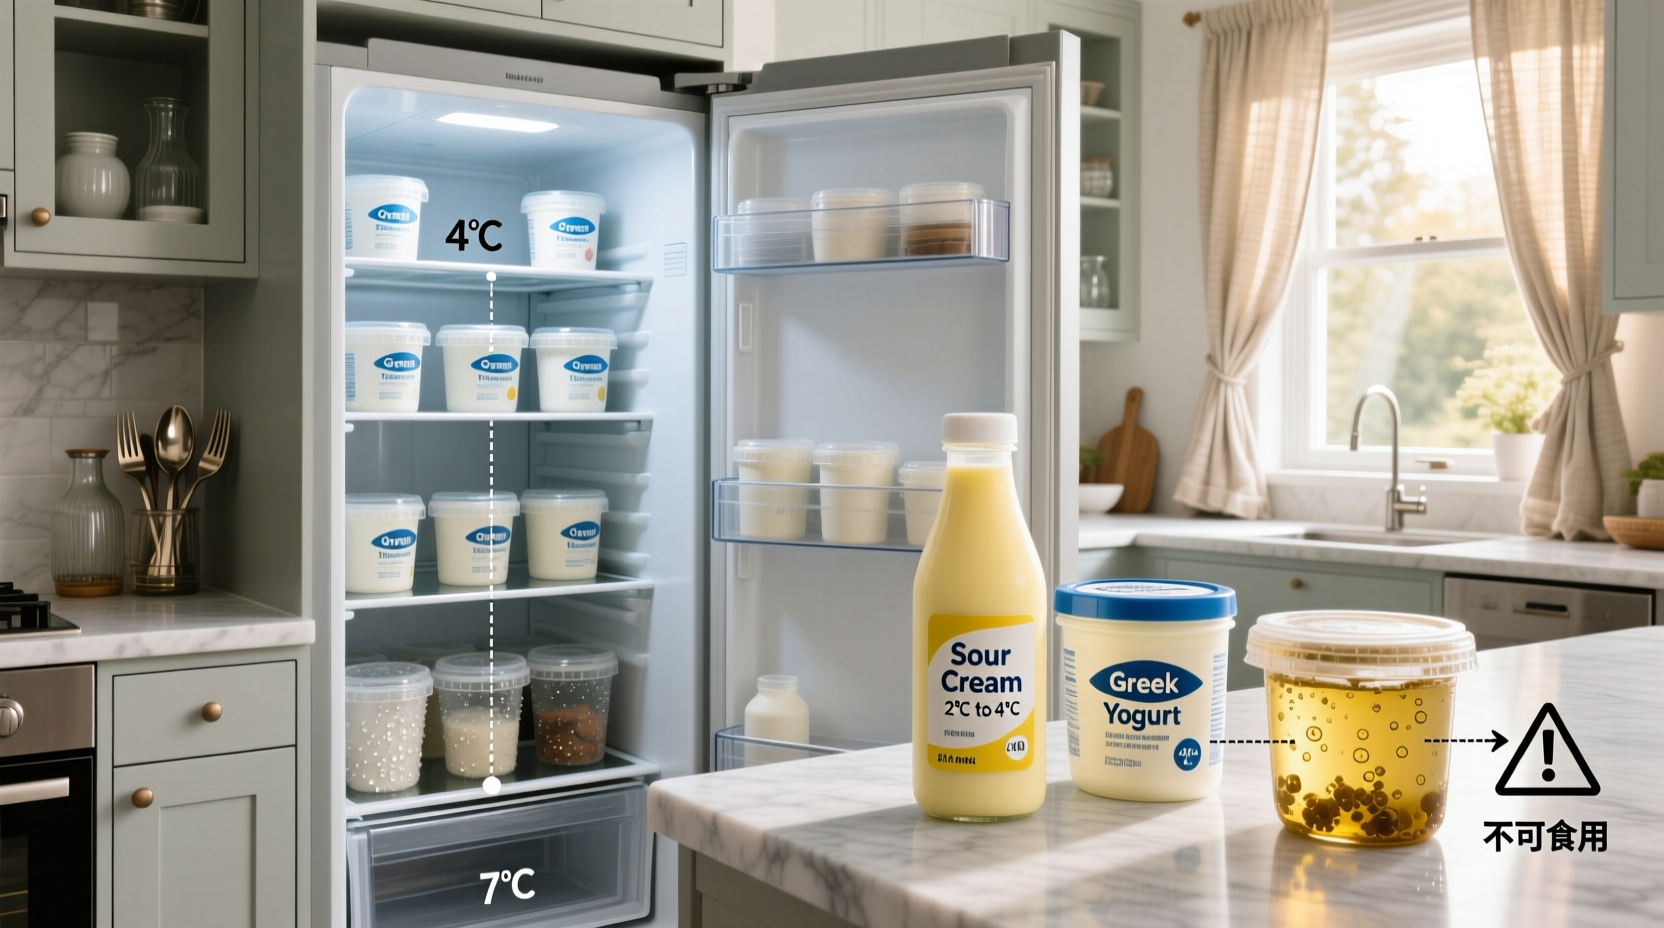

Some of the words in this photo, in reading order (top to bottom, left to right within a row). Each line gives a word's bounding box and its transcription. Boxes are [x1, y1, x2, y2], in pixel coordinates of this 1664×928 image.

[950, 641, 1012, 666] Sour
[941, 669, 1022, 693] Cream
[1109, 671, 1179, 694] Greek
[975, 702, 992, 717] to
[1103, 701, 1182, 732] Yogurt
